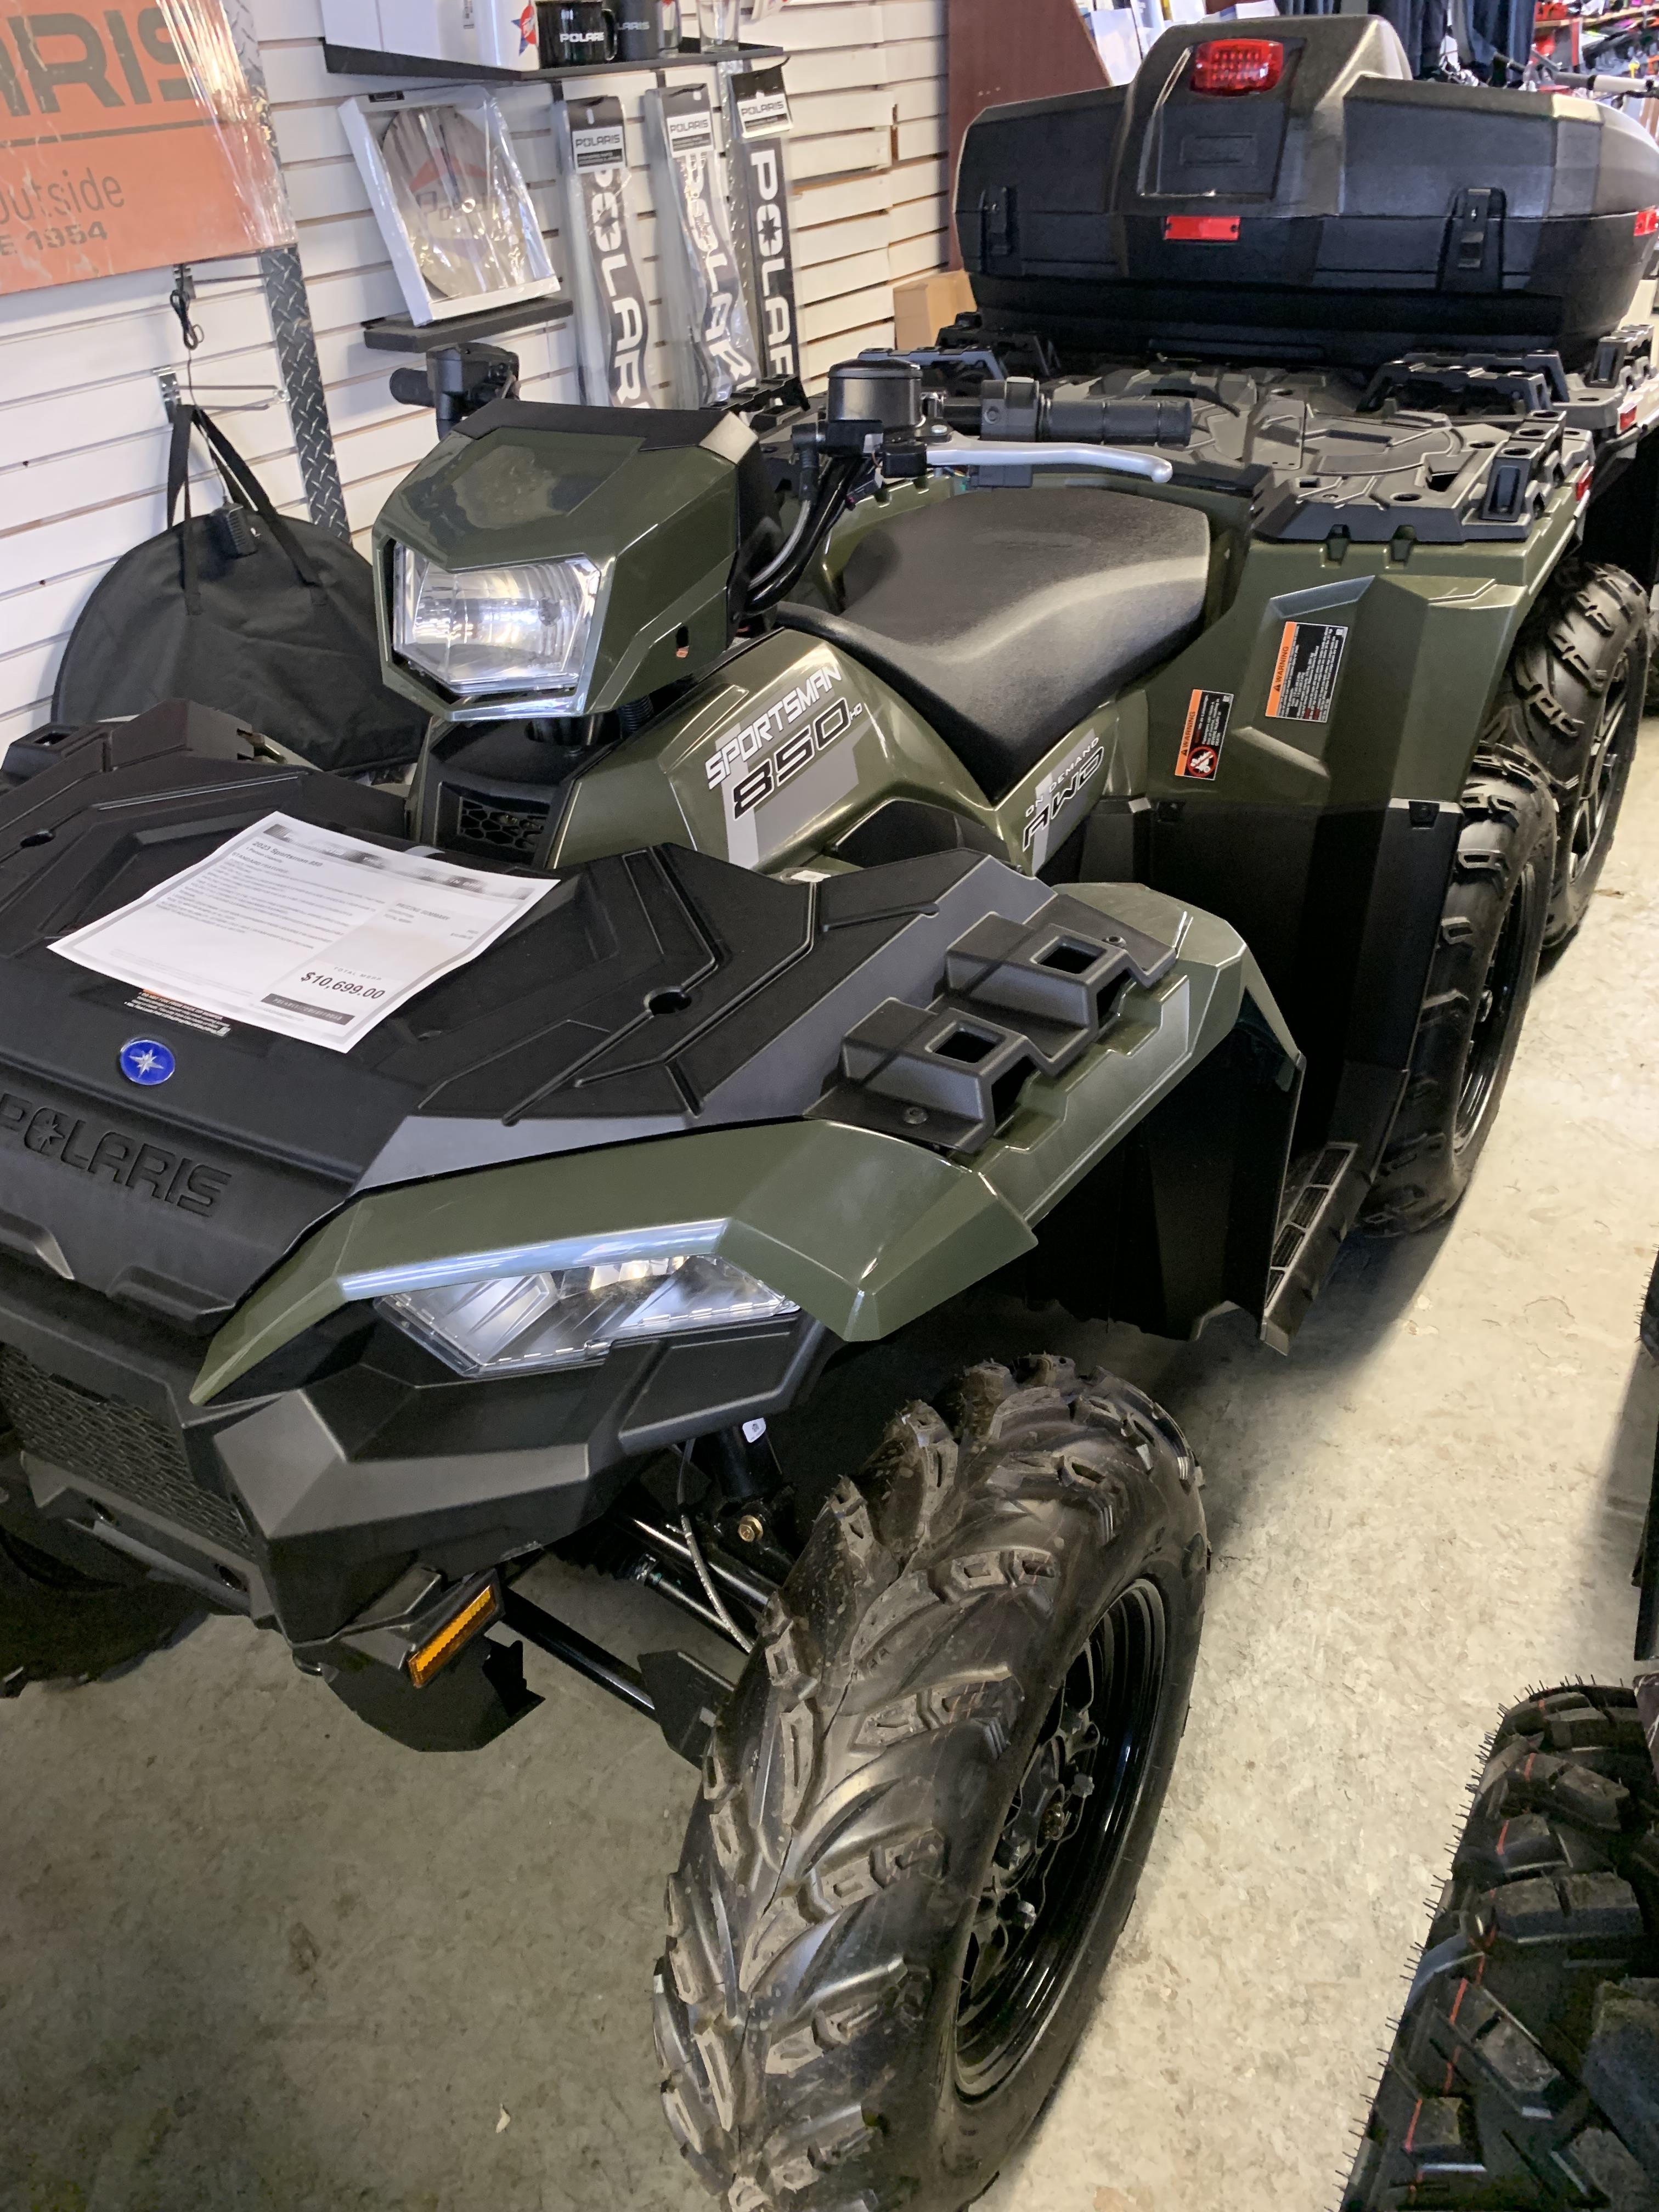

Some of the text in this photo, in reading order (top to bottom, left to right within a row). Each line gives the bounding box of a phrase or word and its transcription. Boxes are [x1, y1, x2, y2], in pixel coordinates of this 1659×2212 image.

[0, 7, 202, 116] RIS
[670, 119, 709, 133] POLARIS
[741, 101, 784, 116] POLARIS
[575, 134, 620, 148] POLARIS
[26, 221, 108, 251] 1954
[591, 169, 651, 409] OLAR
[1276, 646, 1289, 682] WARNING
[704, 663, 842, 791] SPORTSMAN
[1182, 711, 1196, 748] WARNING
[731, 697, 851, 822] 850
[1025, 737, 1099, 817] ON DEMAND
[1022, 746, 1104, 853] AWD
[301, 972, 386, 1000] $10,699.00
[334, 966, 356, 976] TOTAL
[0, 1093, 232, 1217] POLARIS
